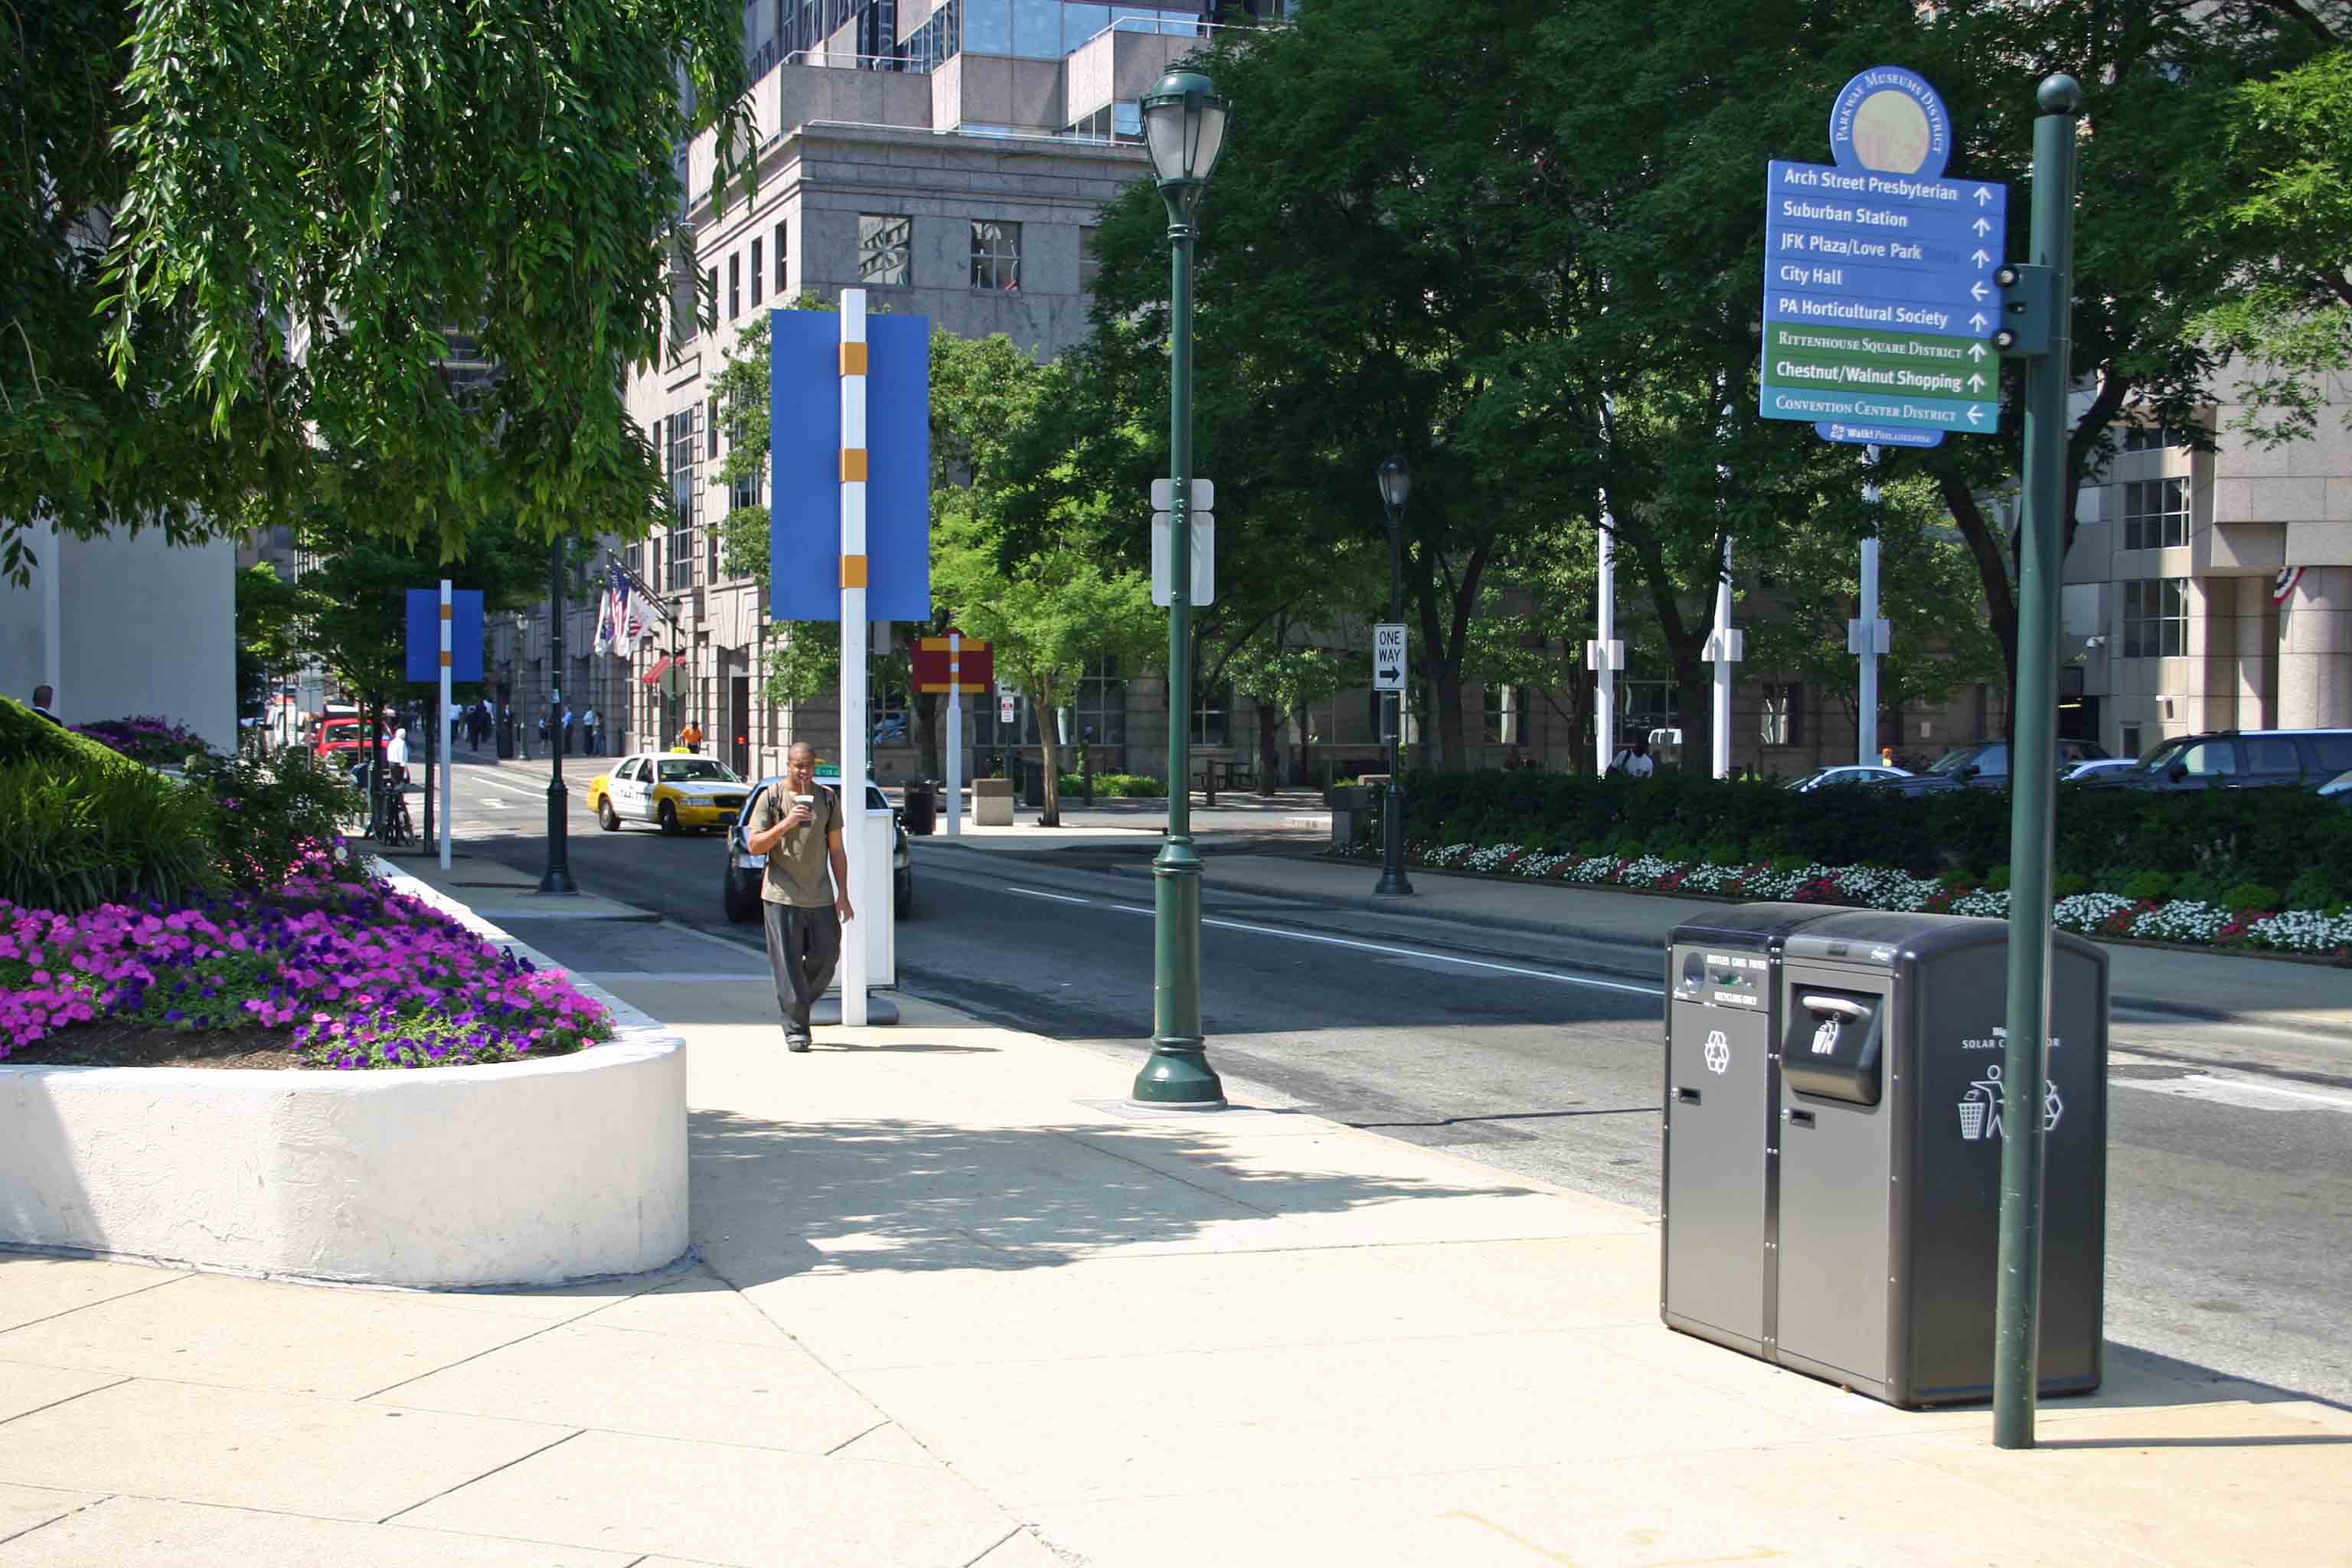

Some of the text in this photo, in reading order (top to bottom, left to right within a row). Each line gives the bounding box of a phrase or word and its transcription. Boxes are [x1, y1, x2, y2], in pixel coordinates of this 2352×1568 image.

[1837, 72, 1943, 154] PARKWAY MUSEUMS DISTRICT
[1784, 168, 1958, 201] Arch Street Presbyterian
[1782, 201, 1907, 227] Suburban Station
[1781, 233, 1922, 260] JFK Plaza/Love Park
[1780, 266, 1842, 286] City Hall
[1779, 298, 1948, 329] PA Horticultural Society
[1779, 331, 1962, 359] RITTENHOUSE SQUARE DISTRICT
[1776, 361, 1962, 393] Chestnut/Walnut Shopping
[1775, 395, 1957, 421] CONVENTION CENTER DISTRICT
[1379, 631, 1400, 645] ONE
[1379, 648, 1401, 662] WAY
[1962, 1039, 1994, 1048] SOLAR
